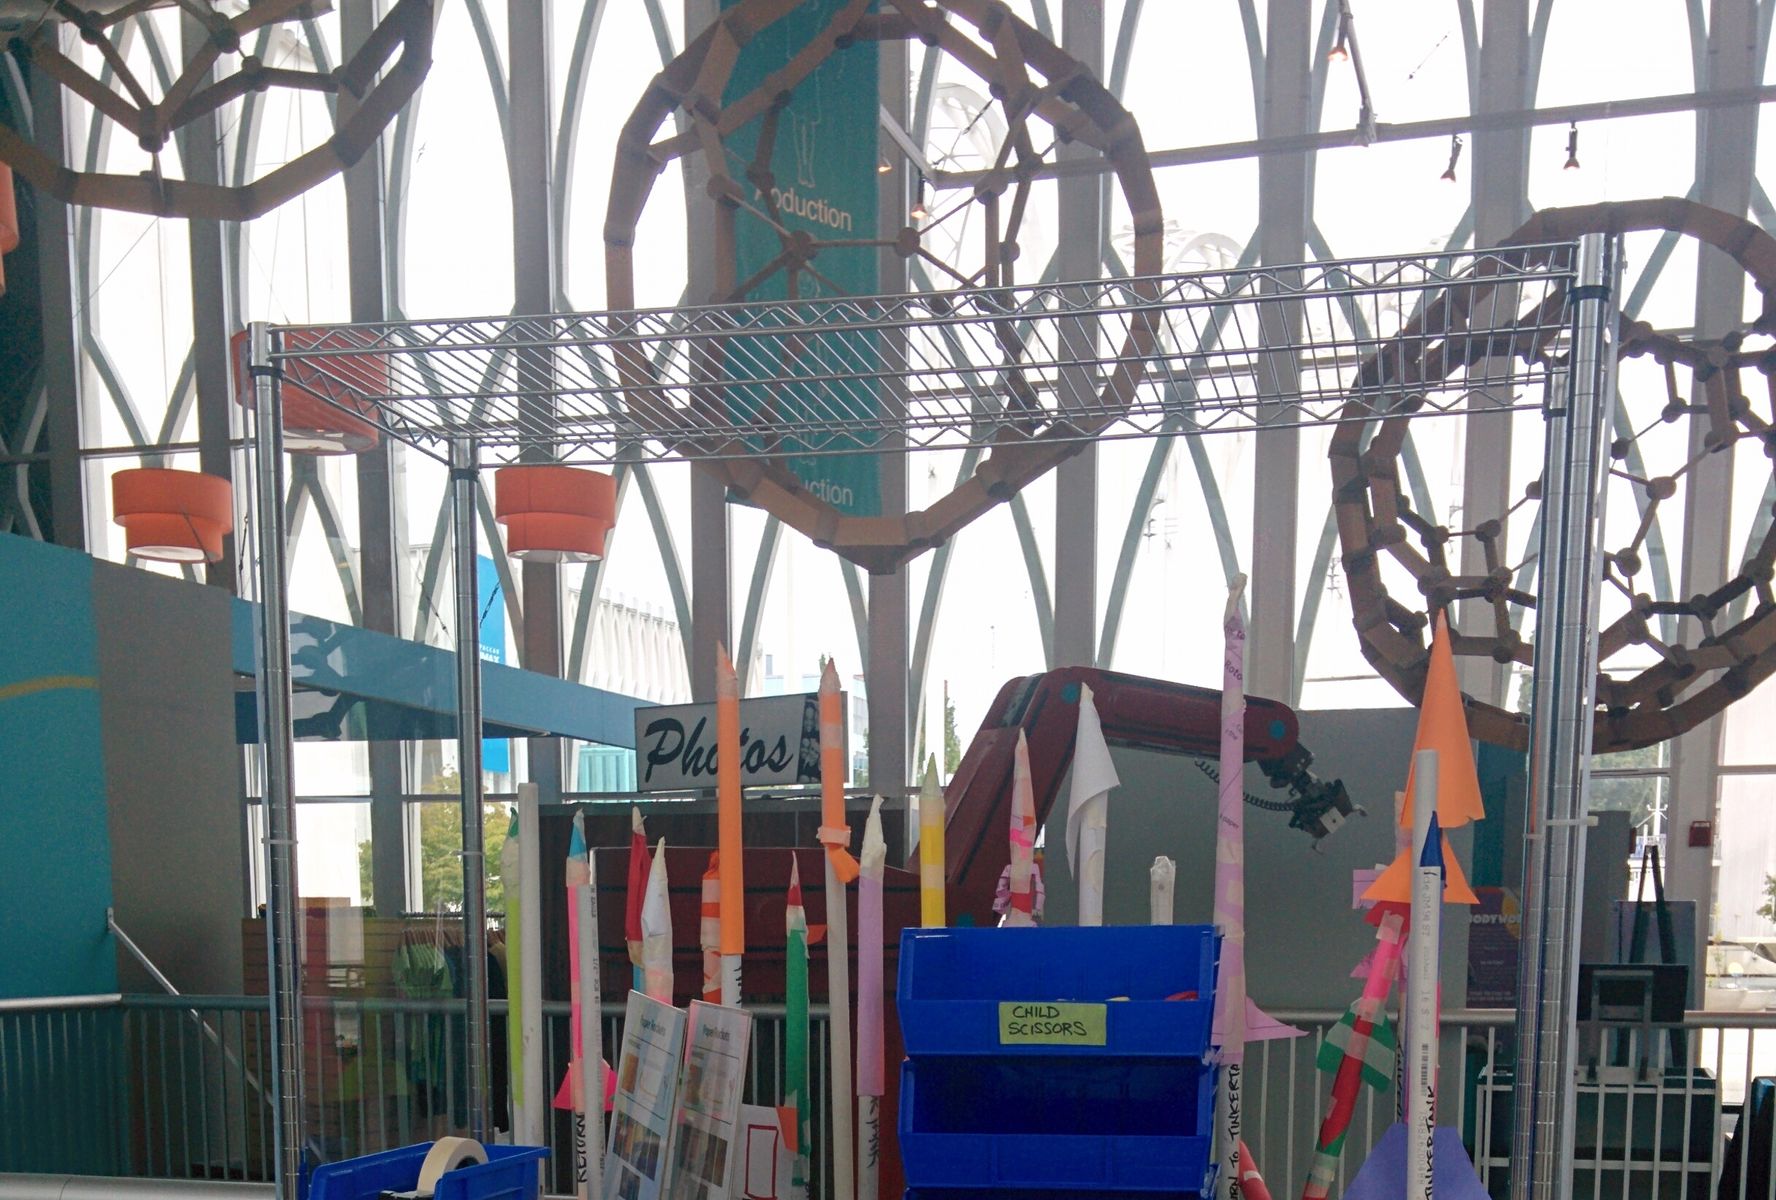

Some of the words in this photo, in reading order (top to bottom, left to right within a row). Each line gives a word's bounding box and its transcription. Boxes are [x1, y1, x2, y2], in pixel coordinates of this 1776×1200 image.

[754, 187, 852, 232] oduction
[1008, 1021, 1088, 1036] SCISSORS
[1012, 1006, 1060, 1018] CHILD
[1228, 1064, 1240, 1141] TINKERTA
[576, 1112, 587, 1184] RETURN
